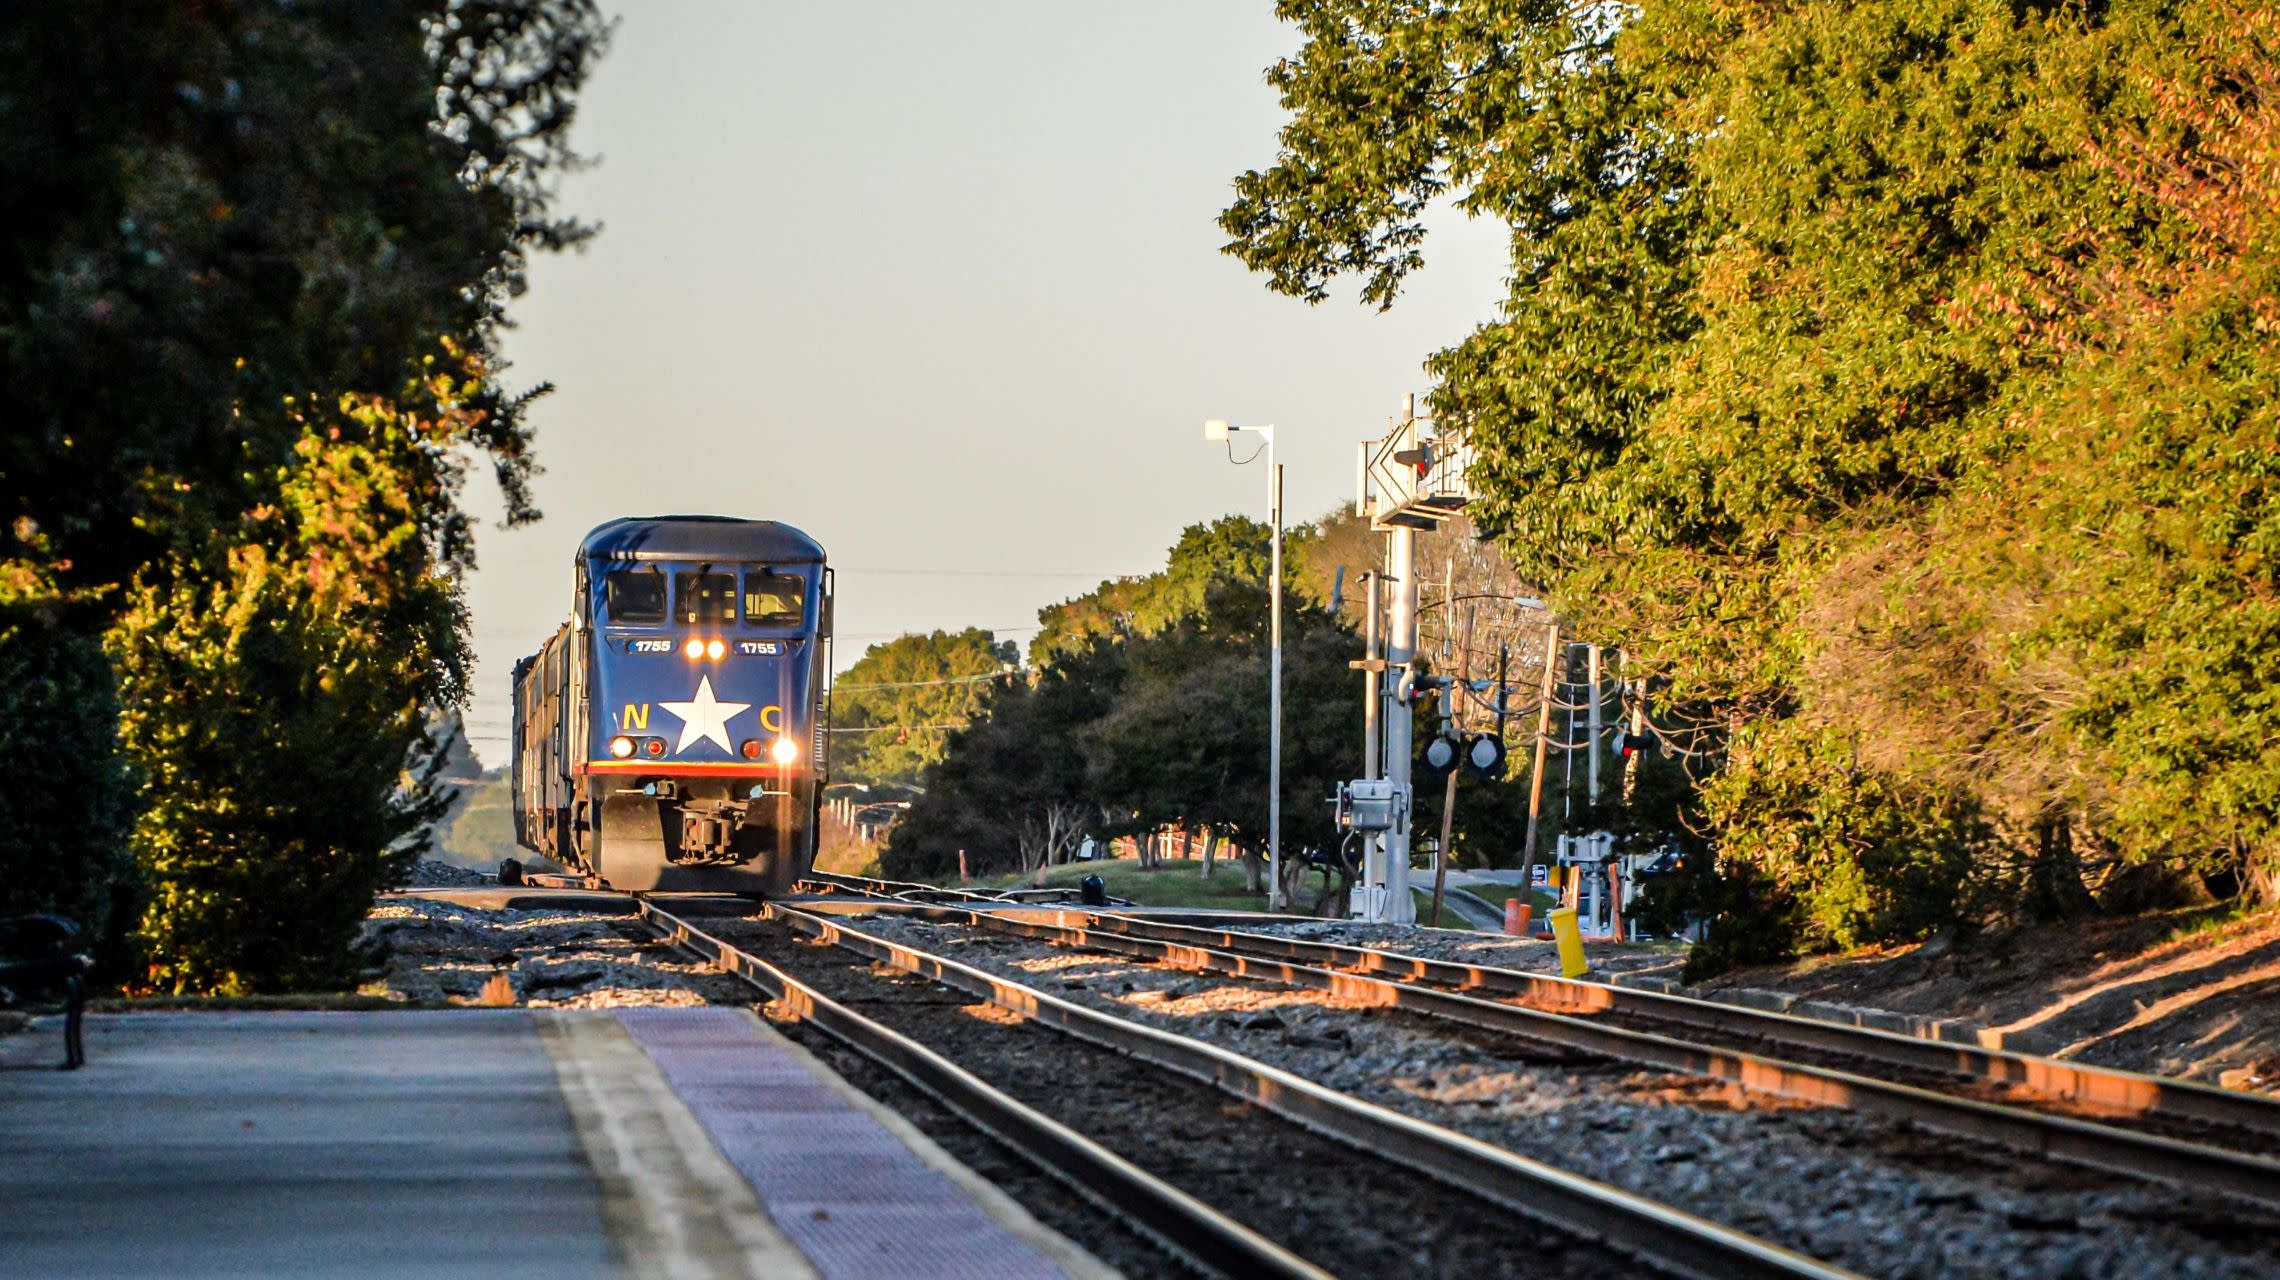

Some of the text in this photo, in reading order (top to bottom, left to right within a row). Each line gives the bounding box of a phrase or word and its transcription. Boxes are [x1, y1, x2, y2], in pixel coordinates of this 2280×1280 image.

[635, 640, 671, 652] 1755
[740, 642, 777, 654] 1755
[622, 703, 784, 733] N C
